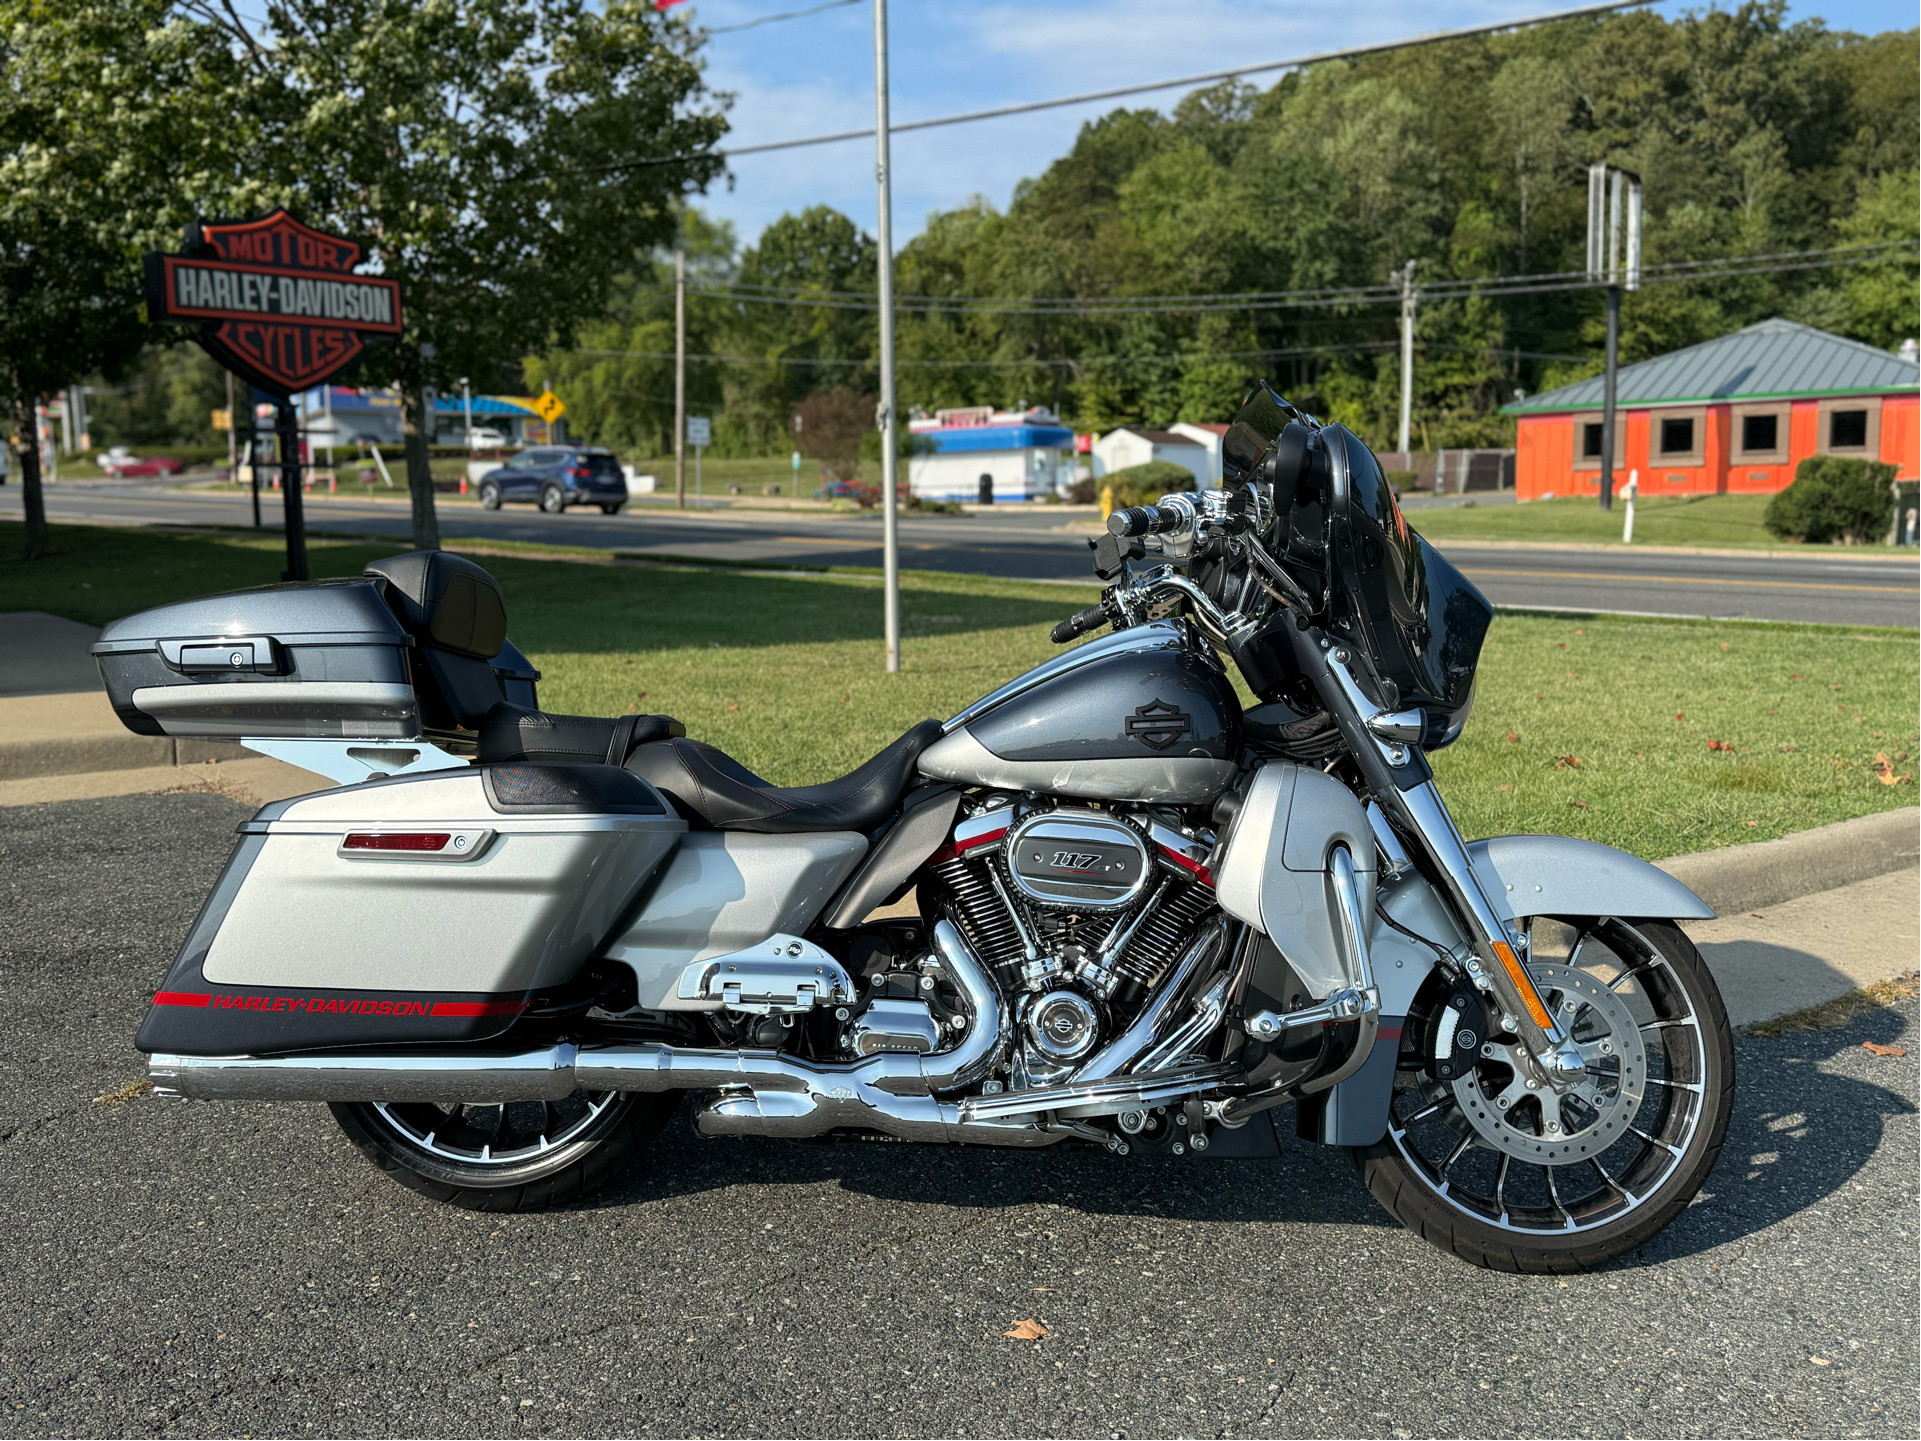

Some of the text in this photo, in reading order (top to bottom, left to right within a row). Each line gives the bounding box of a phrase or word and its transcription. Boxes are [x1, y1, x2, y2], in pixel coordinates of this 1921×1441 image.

[227, 221, 343, 271] MOTOR
[177, 266, 392, 324] HARLEY-DAVIDSON
[236, 322, 346, 378] CYCLES
[1050, 851, 1102, 870] 117
[212, 995, 430, 1017] HARLEY-DAVIDSON
